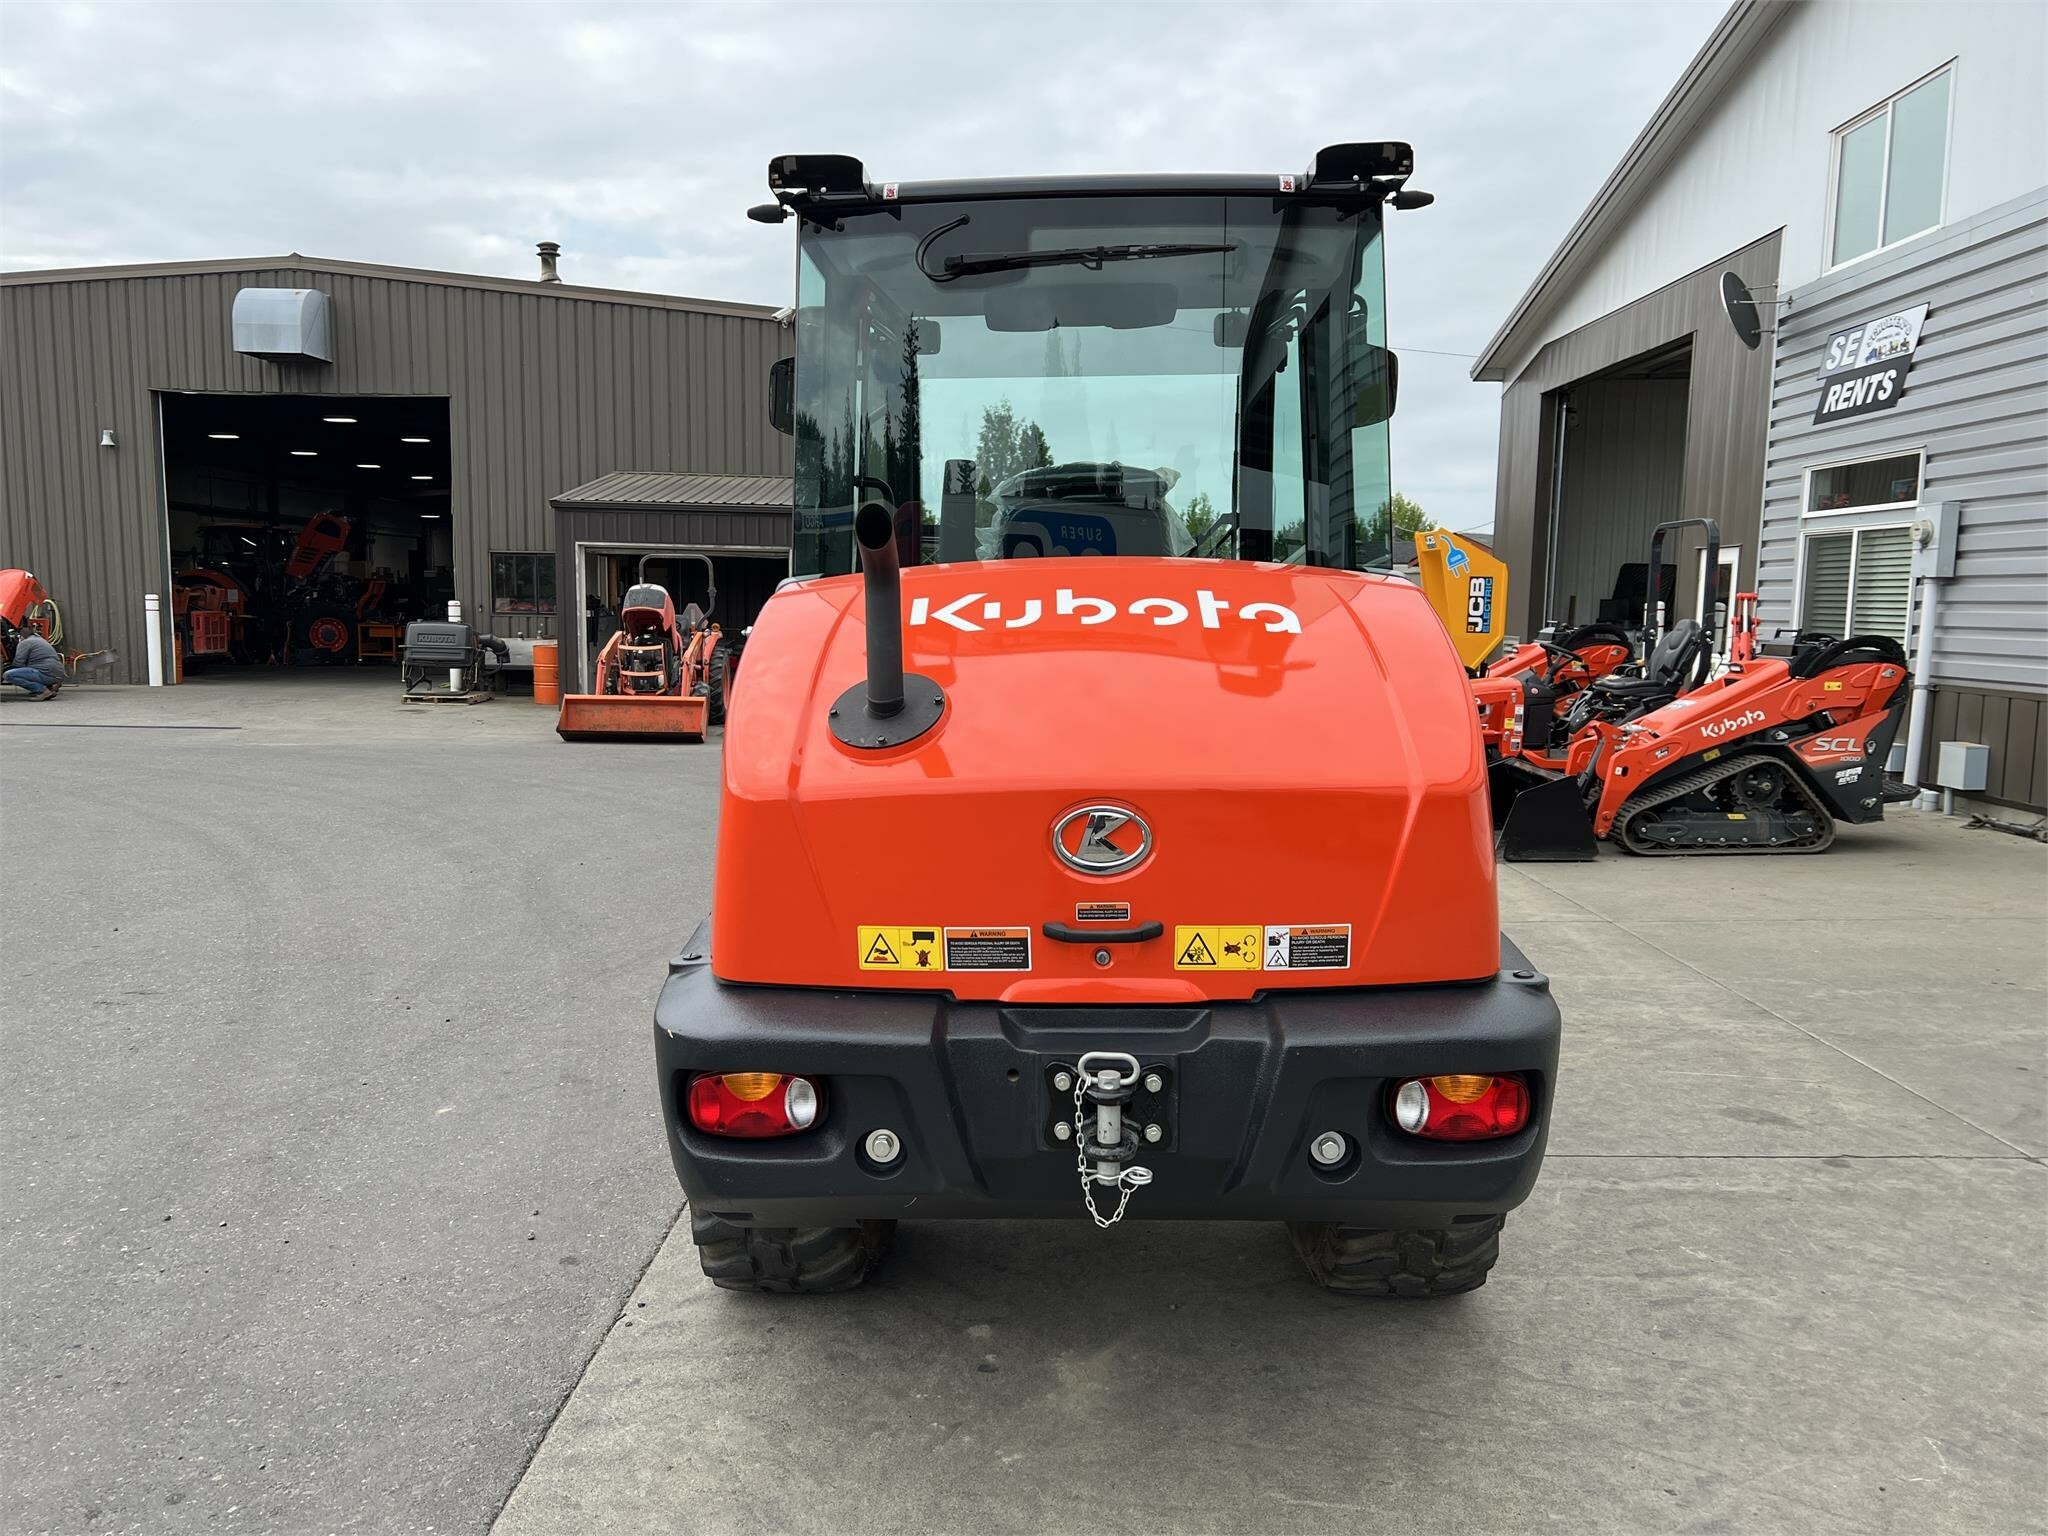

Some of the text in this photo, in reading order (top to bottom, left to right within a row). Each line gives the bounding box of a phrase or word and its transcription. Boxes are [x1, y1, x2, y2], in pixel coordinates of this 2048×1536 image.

[1826, 330, 1864, 370] SE
[1822, 369, 1897, 414] RENTS
[909, 588, 1302, 634] Kubota
[1467, 577, 1486, 633] JCB
[1482, 578, 1493, 633] ELECTRIC
[418, 634, 457, 644] KUBOTA
[1700, 710, 1766, 738] Kubota
[1812, 737, 1862, 752] SCL
